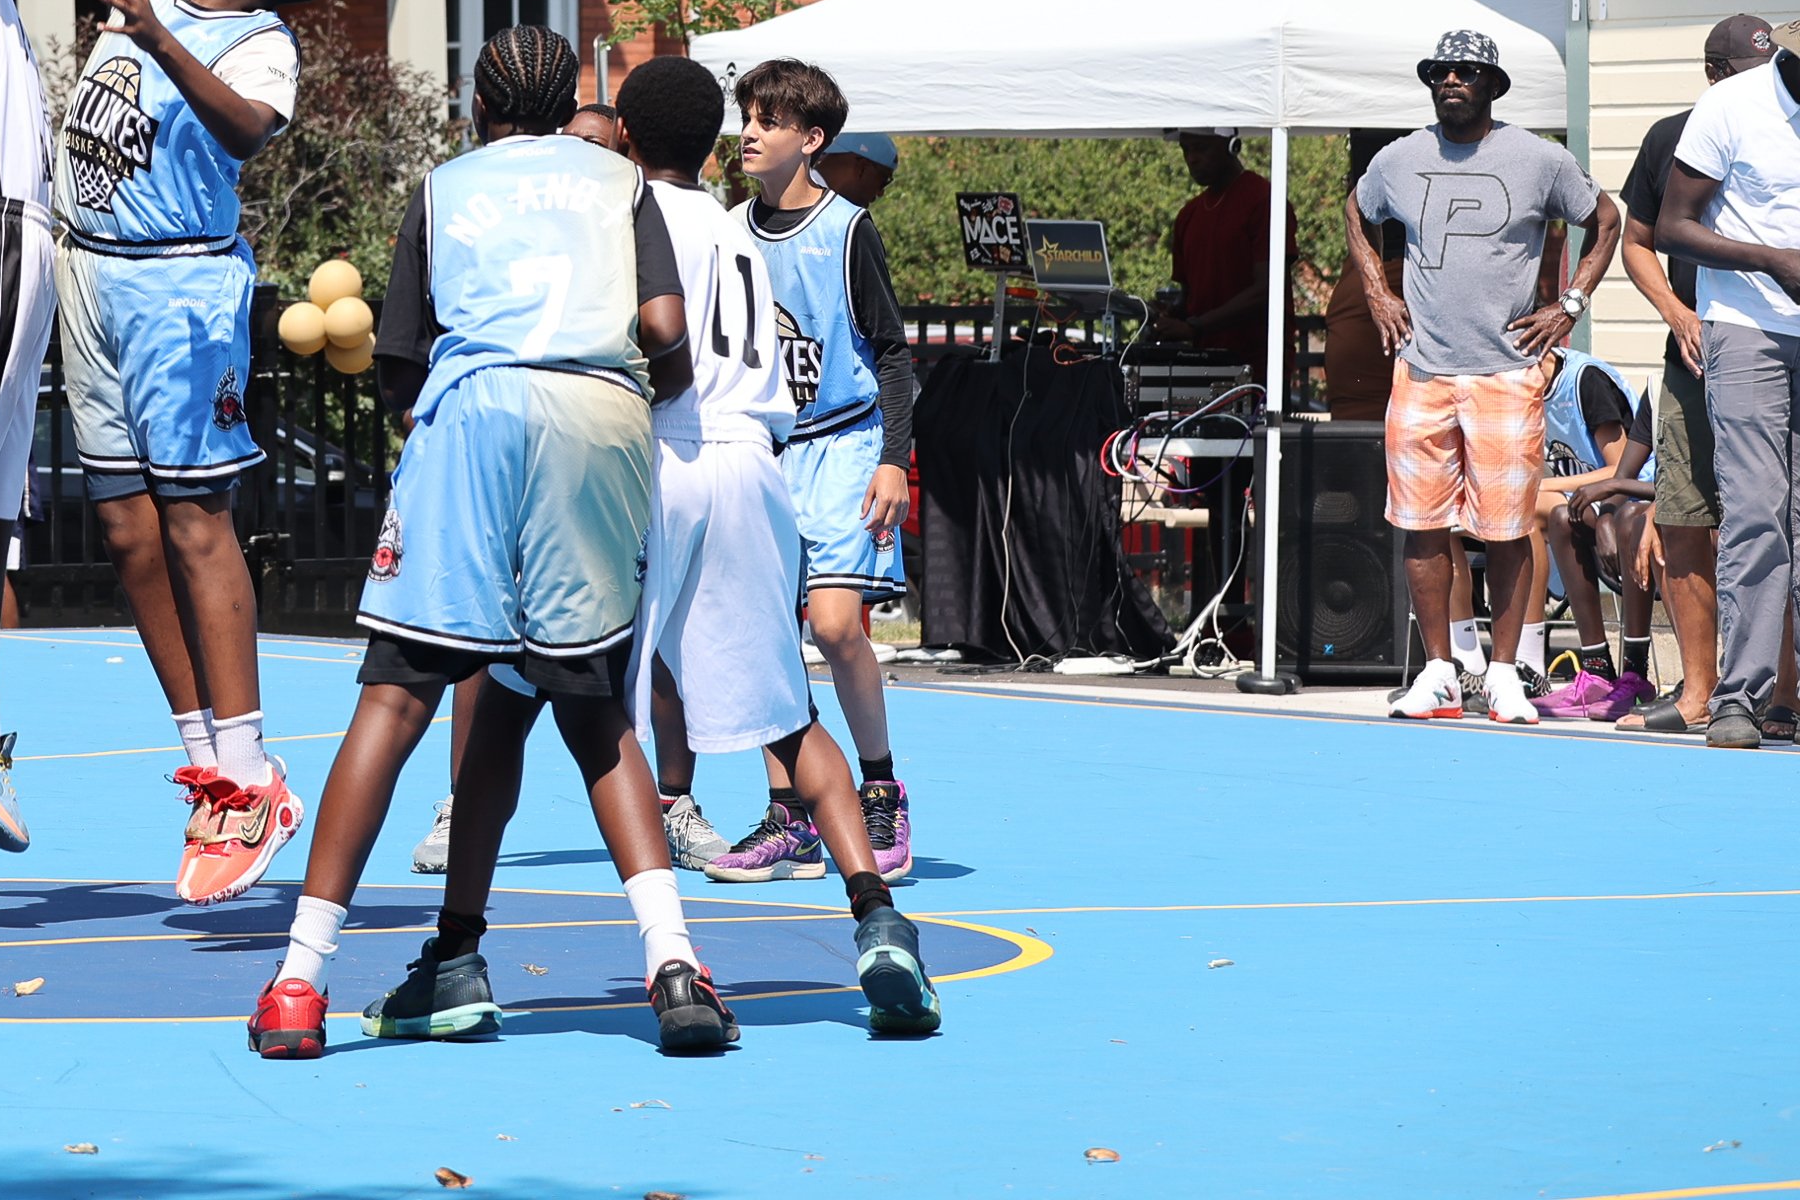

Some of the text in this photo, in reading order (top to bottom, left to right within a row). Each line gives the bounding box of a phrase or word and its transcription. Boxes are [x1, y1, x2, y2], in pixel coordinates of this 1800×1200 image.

[64, 131, 131, 177] BASKEBALL
[1415, 172, 1512, 270] P
[1048, 250, 1103, 263] STARCHILD
[167, 298, 208, 308] BRODIE
[508, 254, 574, 362] 7
